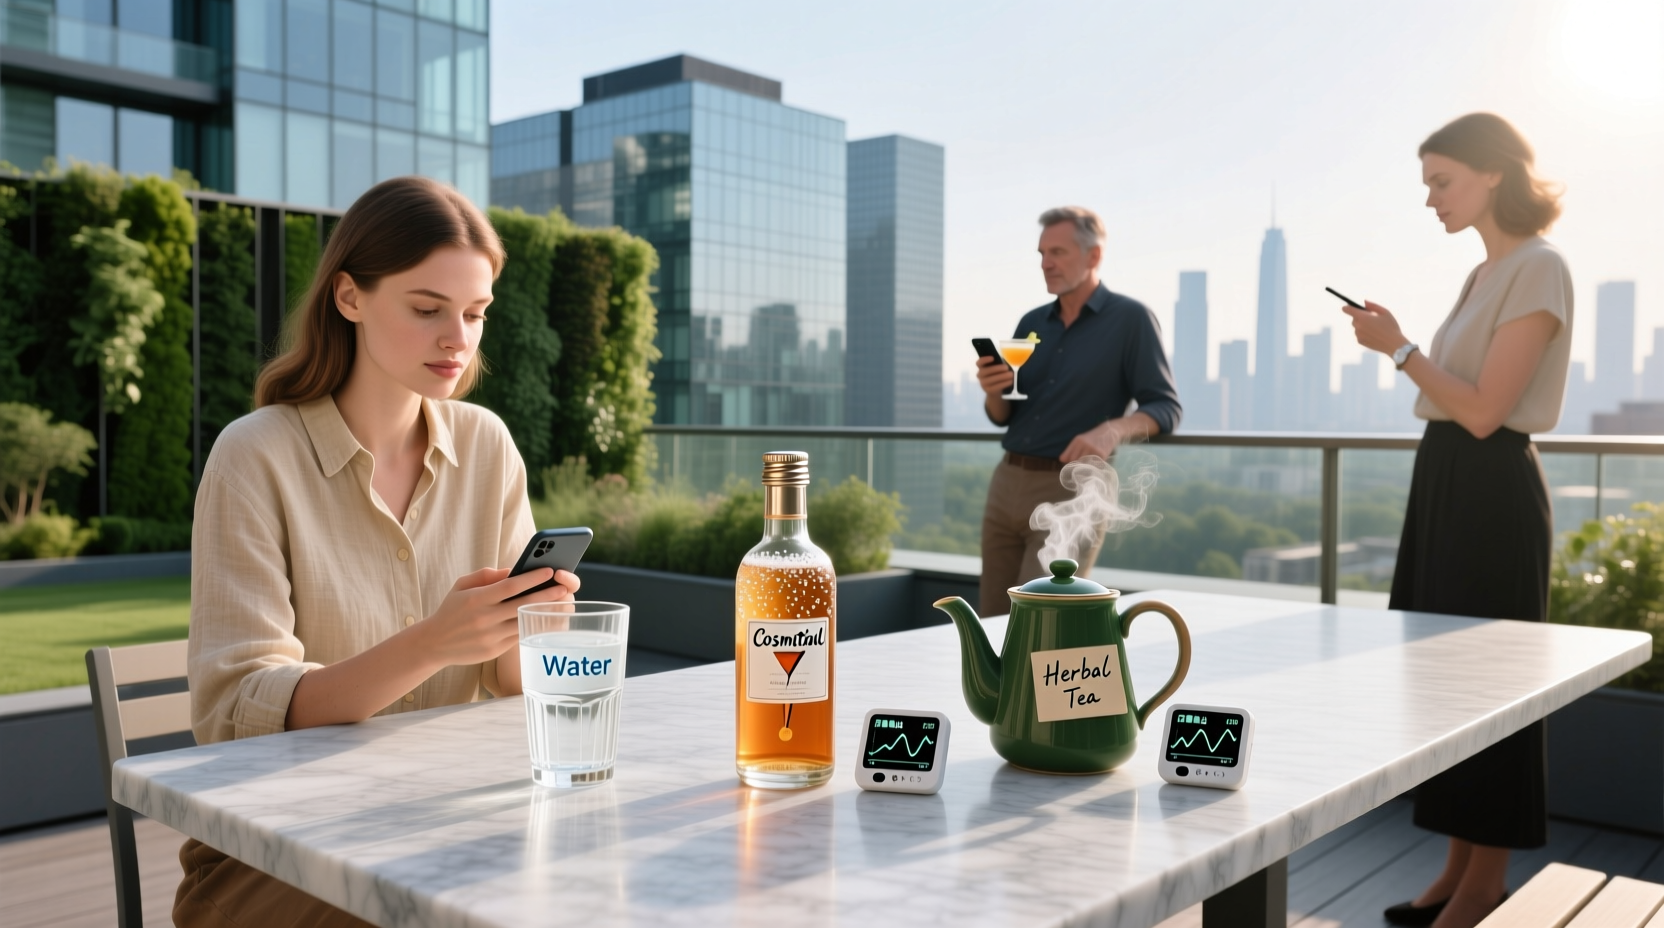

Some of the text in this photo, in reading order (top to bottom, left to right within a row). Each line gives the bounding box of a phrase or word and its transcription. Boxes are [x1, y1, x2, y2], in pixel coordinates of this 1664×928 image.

[542, 654, 612, 677] Water
[1043, 654, 1111, 686] Herbal
[1063, 686, 1101, 709] Tea
